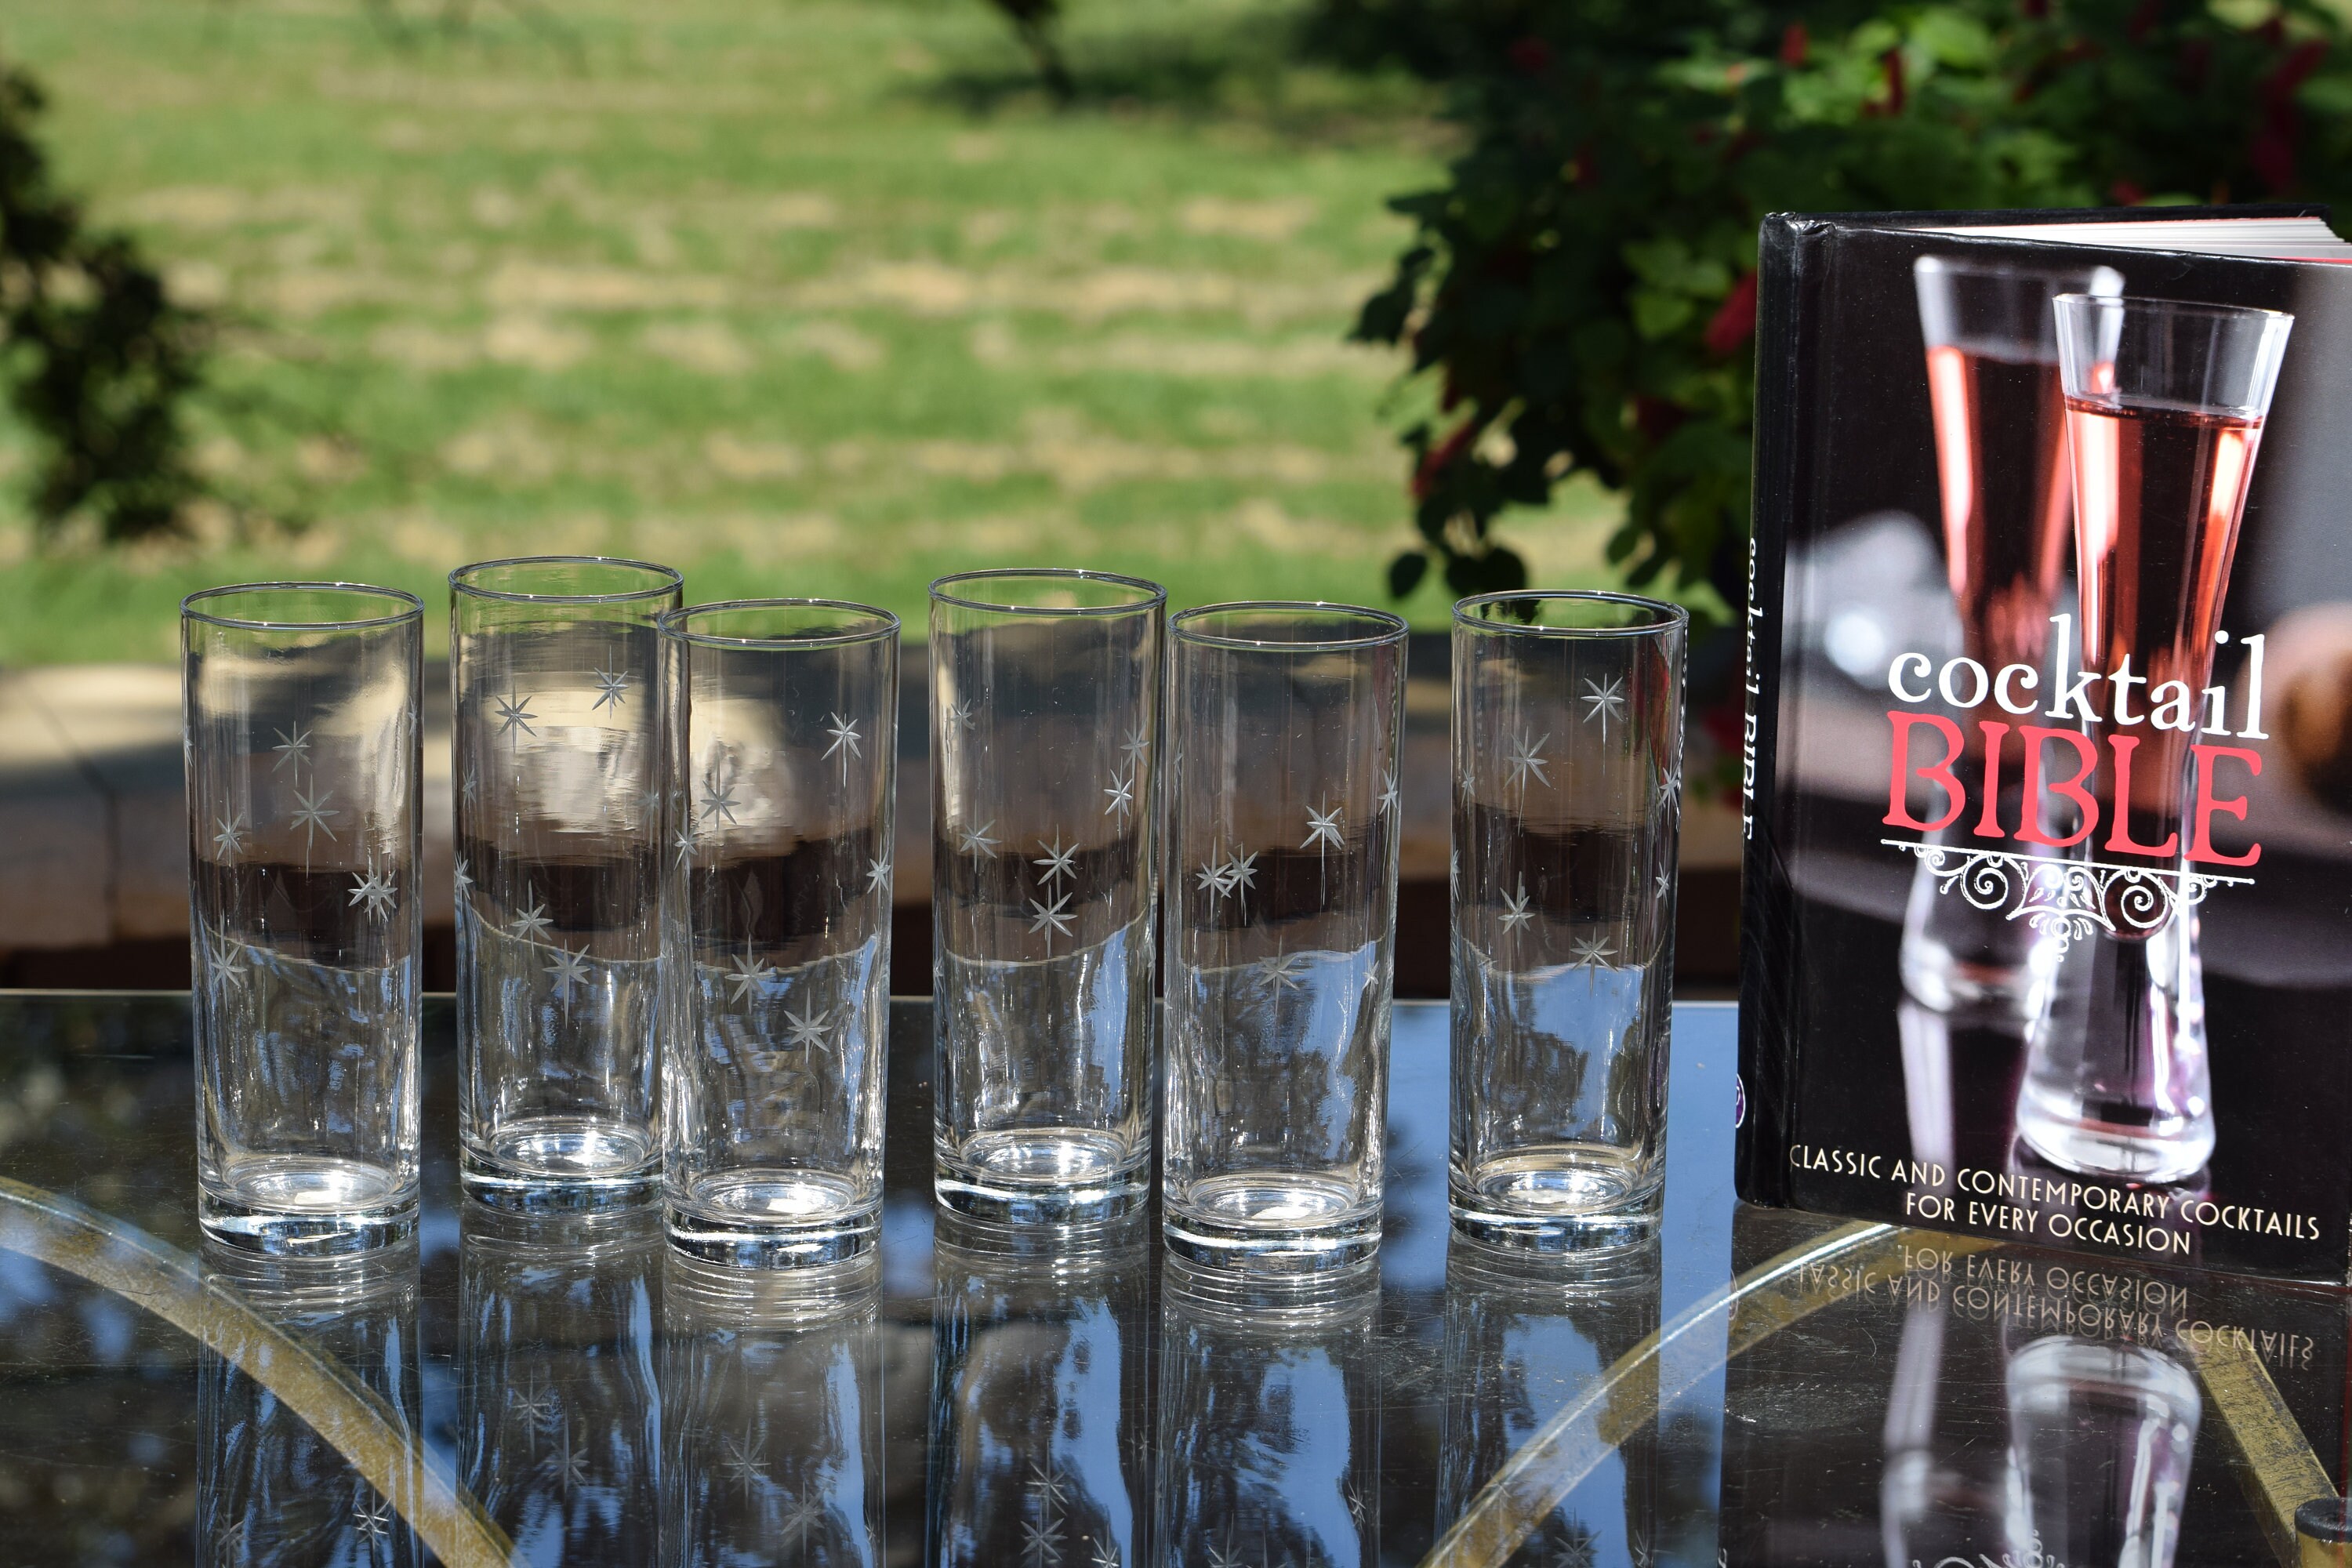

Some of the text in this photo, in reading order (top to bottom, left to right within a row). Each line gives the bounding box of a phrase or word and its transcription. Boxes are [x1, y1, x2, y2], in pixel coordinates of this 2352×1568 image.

[1887, 613, 2270, 740] cocktail
[1882, 710, 2263, 866] BIBLE
[1790, 1144, 2320, 1241] CLASSIC AND CONTEMPORARY COCKTAILS
[1906, 1192, 2190, 1255] FOR EVERY OCCASION
